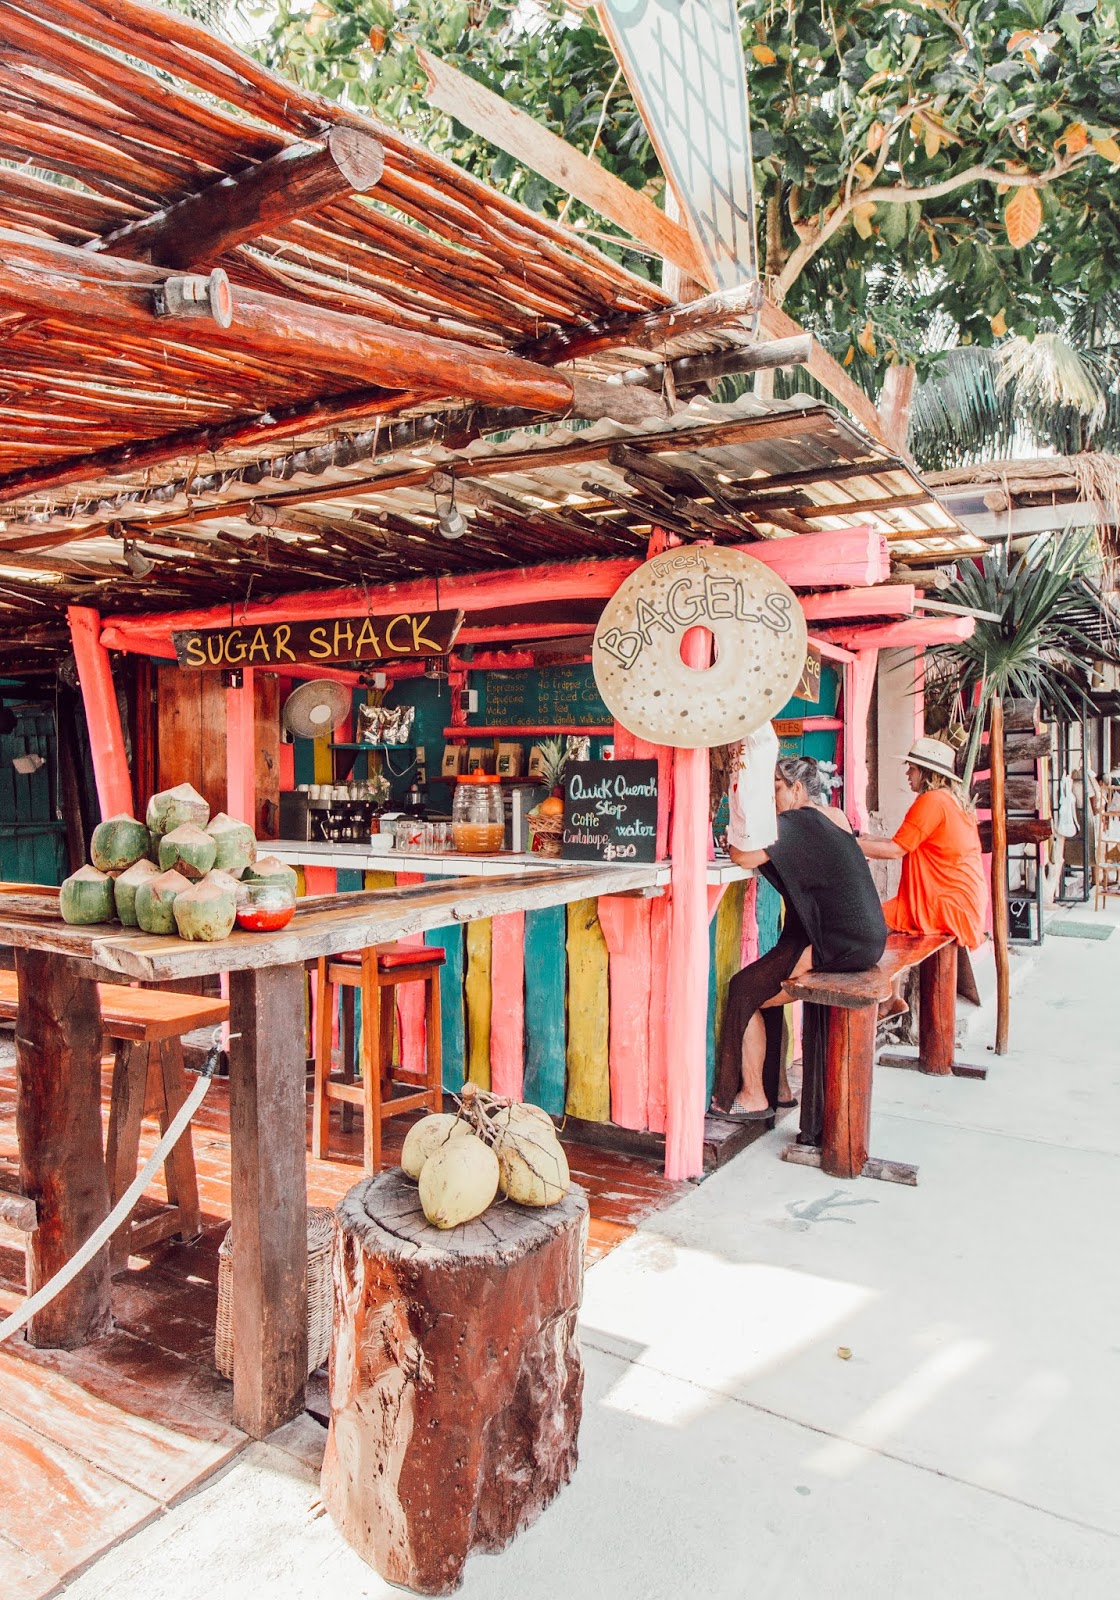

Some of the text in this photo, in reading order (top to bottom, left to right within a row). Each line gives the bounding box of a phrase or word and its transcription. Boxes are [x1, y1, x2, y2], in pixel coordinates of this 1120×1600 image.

[650, 550, 707, 578] Fresh
[598, 575, 791, 670] BAGELS
[186, 614, 442, 666] SUGAR SHACK
[486, 681, 524, 693] Espresso
[553, 690, 577, 701] Iced
[553, 702, 569, 713] Tea
[486, 717, 508, 726] Latte
[570, 774, 657, 800] Quick Quench
[571, 812, 599, 827] Coffe
[616, 819, 656, 836] water
[603, 843, 636, 861] $50
